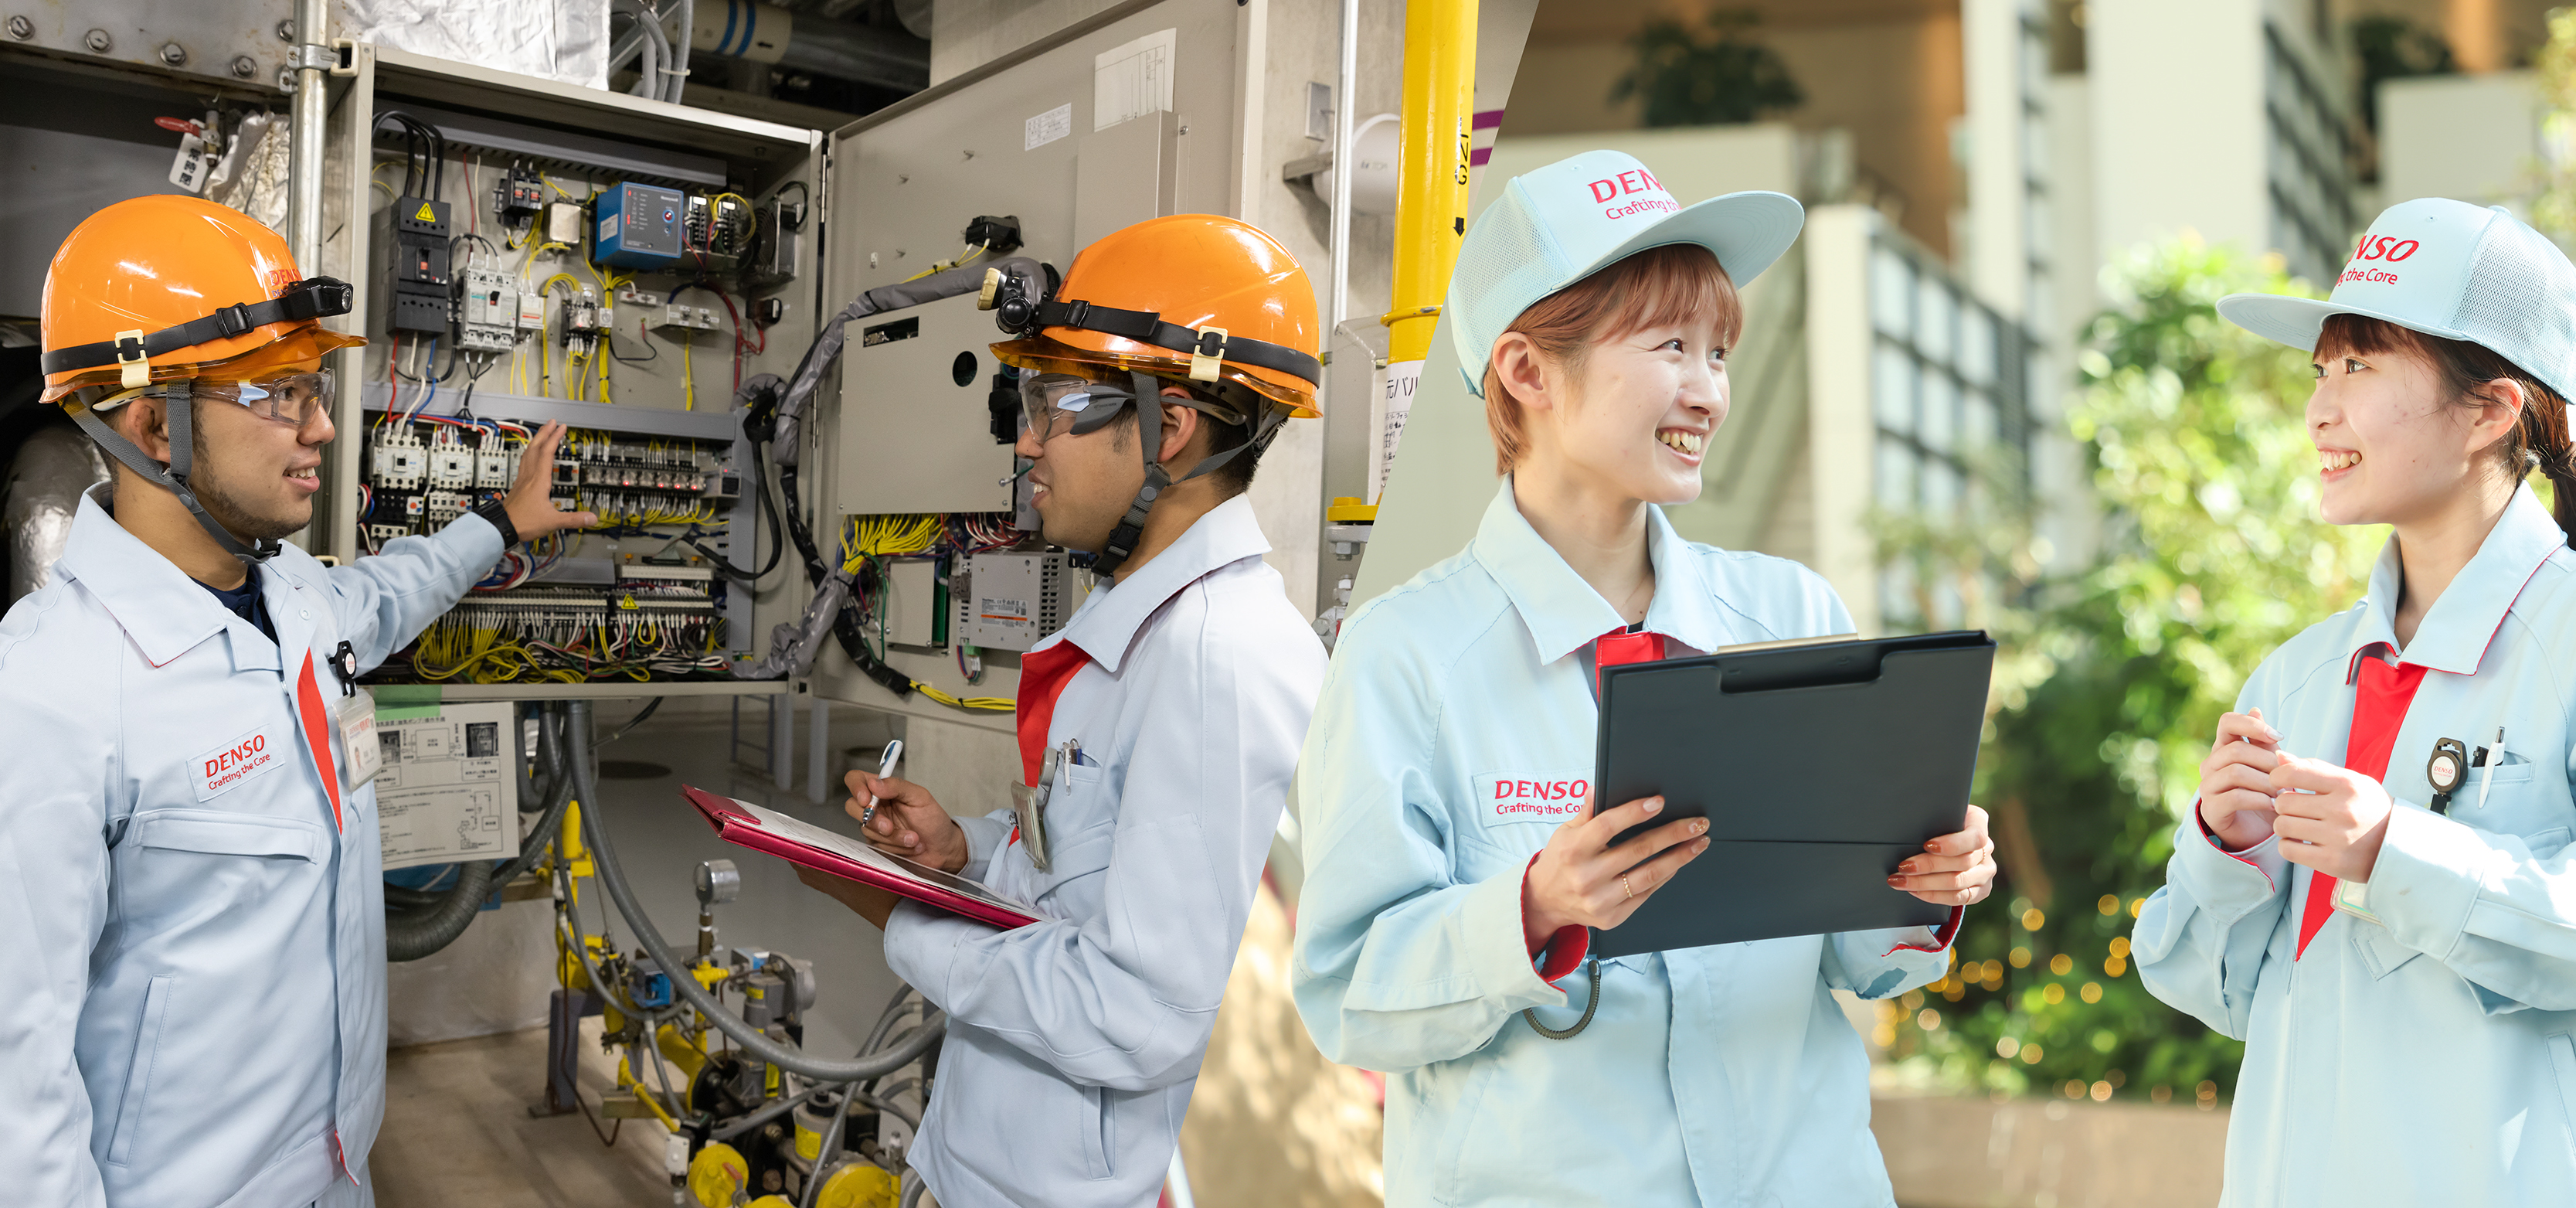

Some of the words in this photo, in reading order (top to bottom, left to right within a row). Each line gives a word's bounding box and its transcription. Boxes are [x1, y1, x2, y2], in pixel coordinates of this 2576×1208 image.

[1587, 168, 1664, 204] DEN
[1606, 199, 1668, 220] Crafting
[1666, 198, 1683, 212] th
[2346, 234, 2419, 262] NSO
[2346, 267, 2364, 282] the
[2366, 268, 2398, 285] Core
[205, 734, 265, 778] DENSO
[209, 771, 242, 791] Crafting
[241, 763, 253, 774] the
[253, 754, 270, 767] Core
[2435, 766, 2453, 774] DENSO
[1495, 779, 1588, 800] DENSO
[1497, 802, 1542, 815] Crafting
[1545, 805, 1562, 815] the
